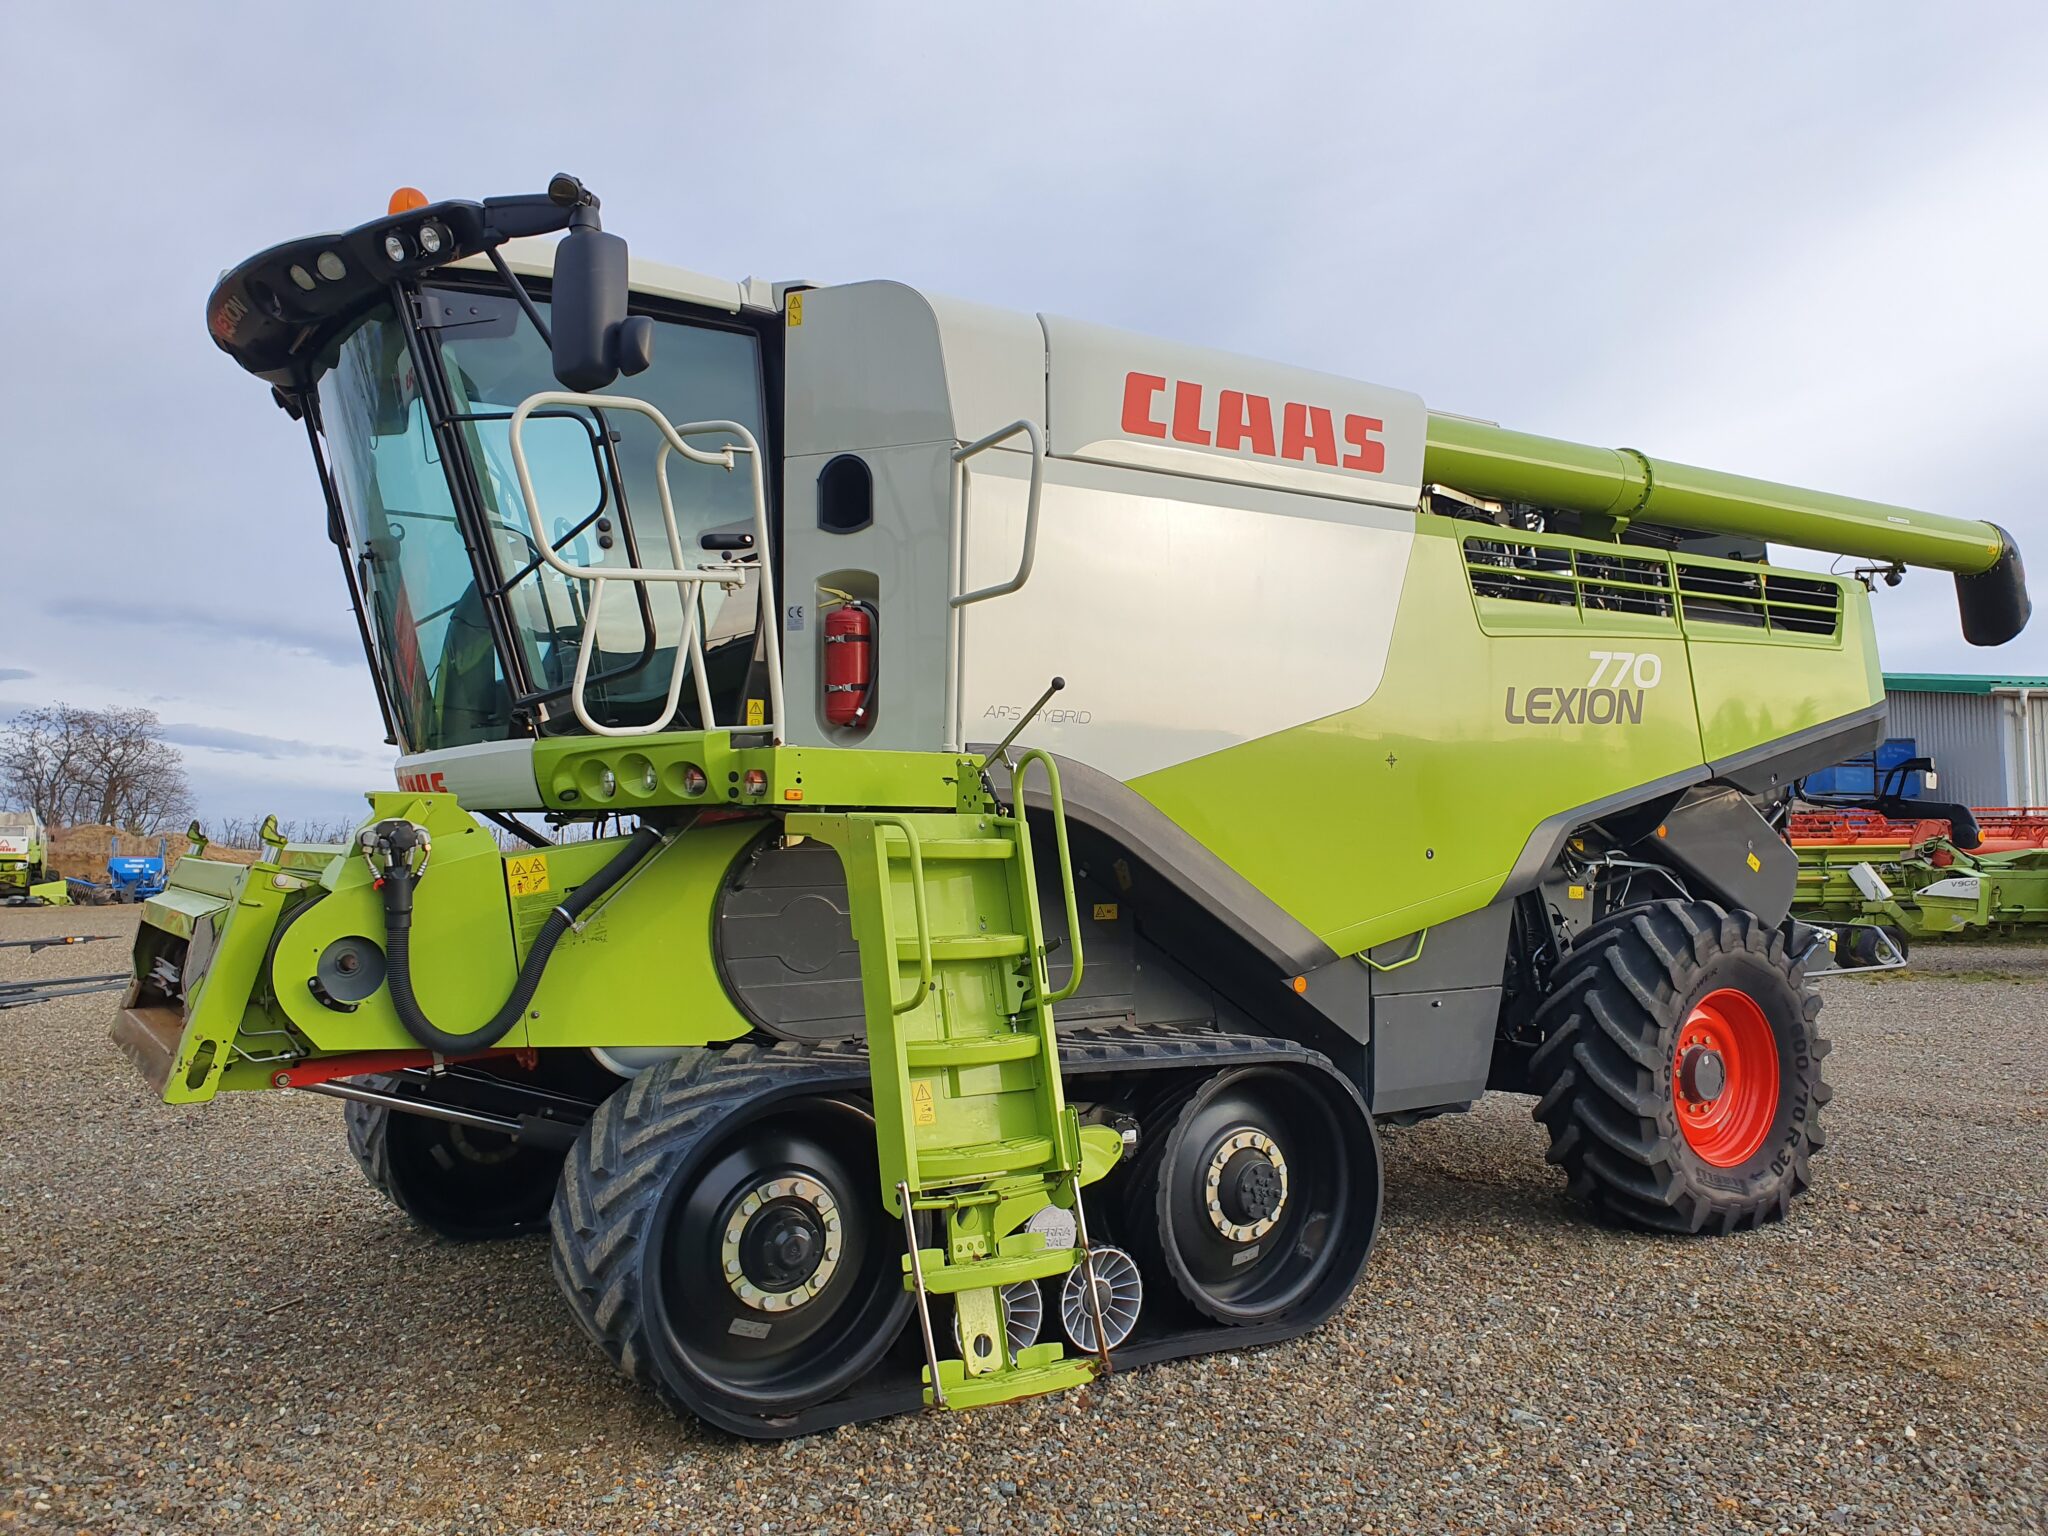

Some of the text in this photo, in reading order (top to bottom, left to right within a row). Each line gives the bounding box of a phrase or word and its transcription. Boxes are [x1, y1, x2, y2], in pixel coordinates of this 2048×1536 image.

[1121, 371, 1385, 473] CLAAS
[1588, 651, 1662, 688] 770
[1505, 687, 1644, 724] LEXION
[1664, 1044, 1674, 1102] 900
[1785, 1127, 1802, 1147] R
[1770, 1149, 1791, 1177] 30
